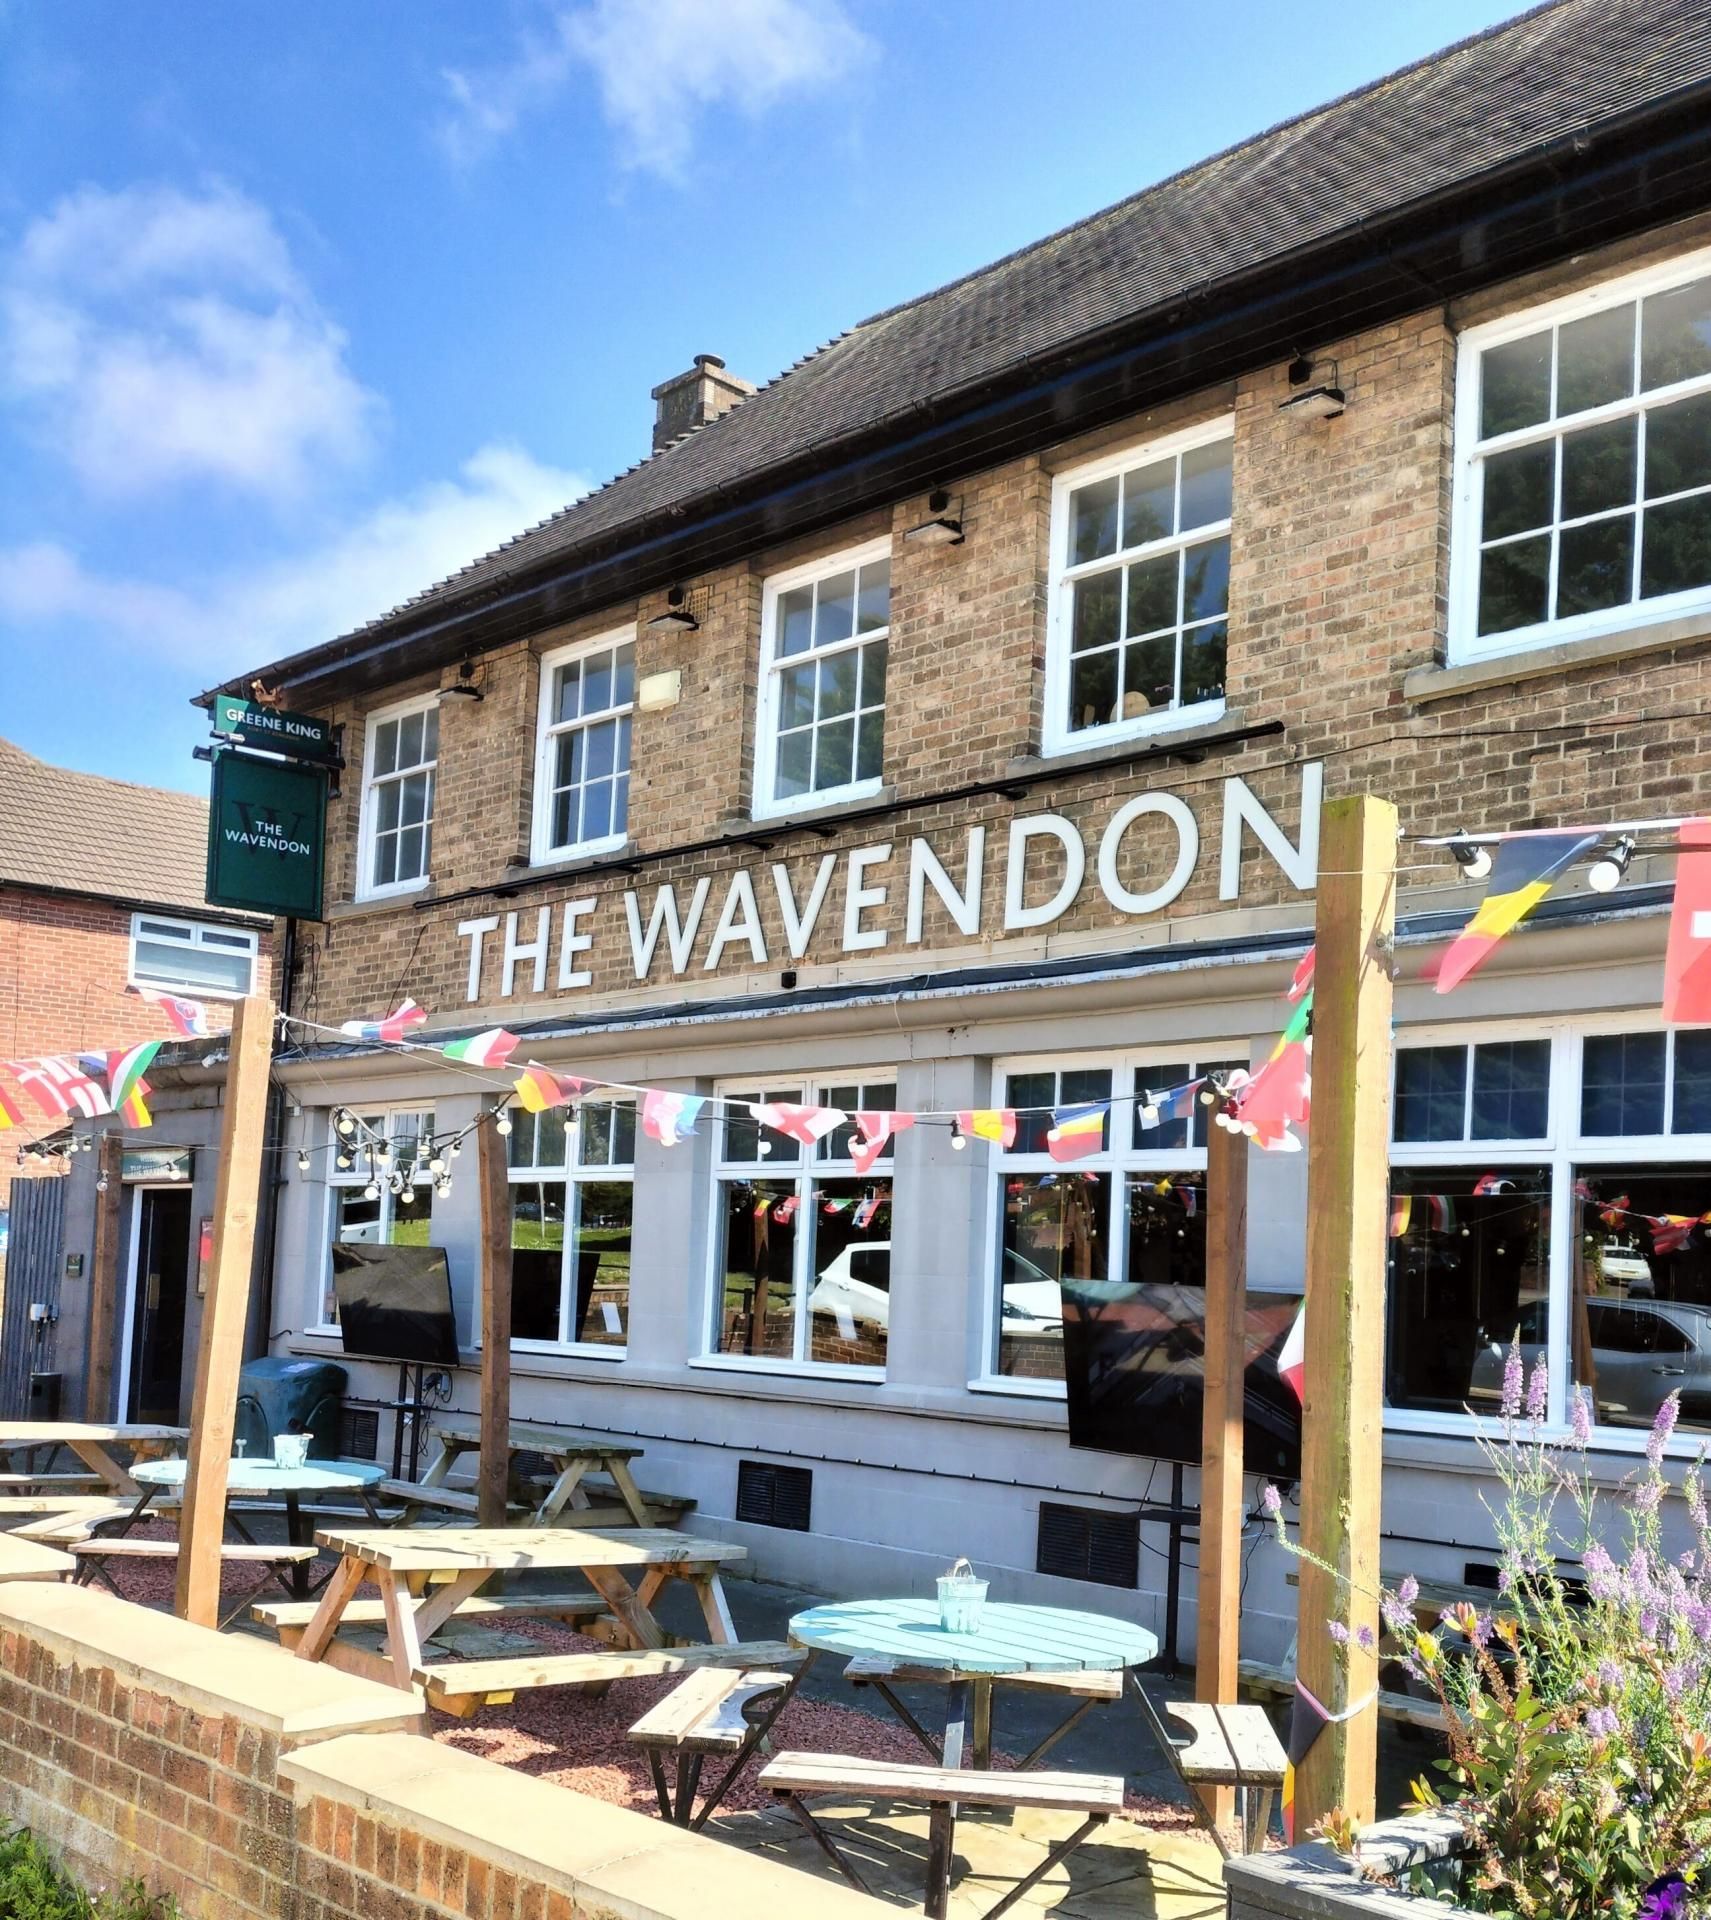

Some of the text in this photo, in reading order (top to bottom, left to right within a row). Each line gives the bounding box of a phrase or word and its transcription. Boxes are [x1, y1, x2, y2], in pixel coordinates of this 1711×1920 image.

[226, 708, 282, 731] GREENE
[285, 721, 321, 740] KING
[226, 829, 309, 855] WAVENDON
[255, 820, 283, 837] THE
[457, 761, 1324, 1002] THE WAVENDON
